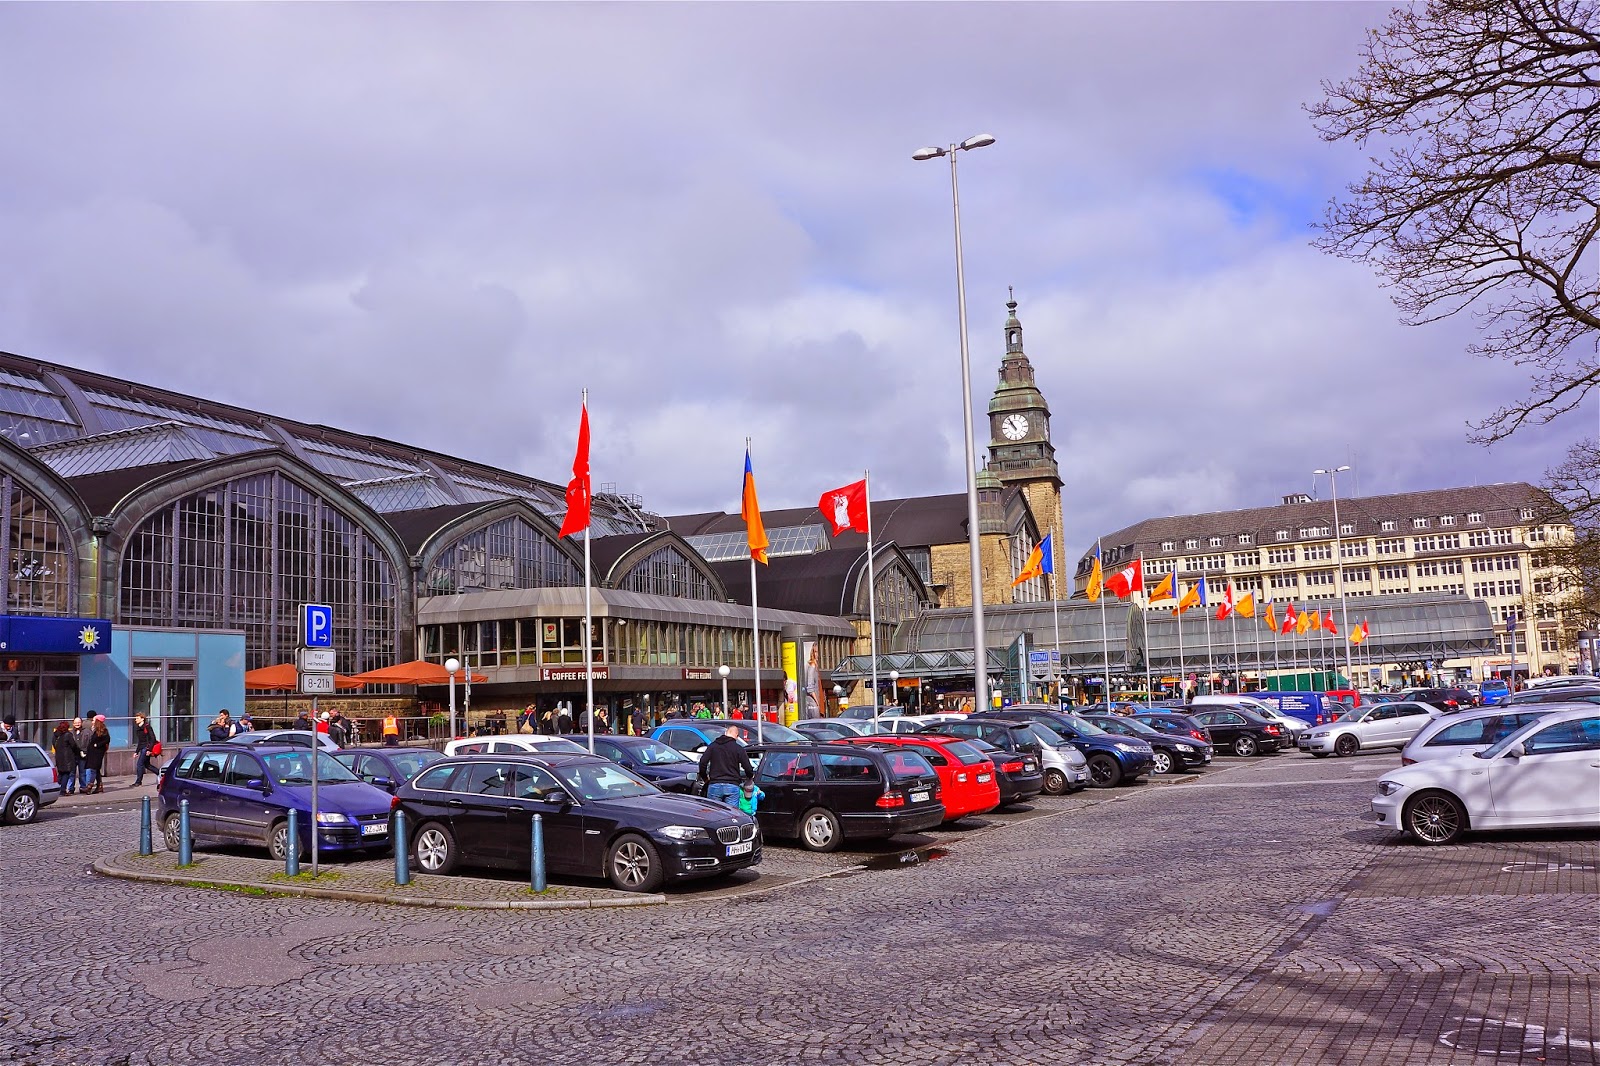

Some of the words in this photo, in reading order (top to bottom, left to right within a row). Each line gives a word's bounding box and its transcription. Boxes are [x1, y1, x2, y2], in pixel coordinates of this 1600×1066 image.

[312, 610, 327, 642] P
[551, 672, 577, 681] COFFEE
[577, 671, 607, 680] FELOWS
[307, 678, 330, 689] 8-21h
